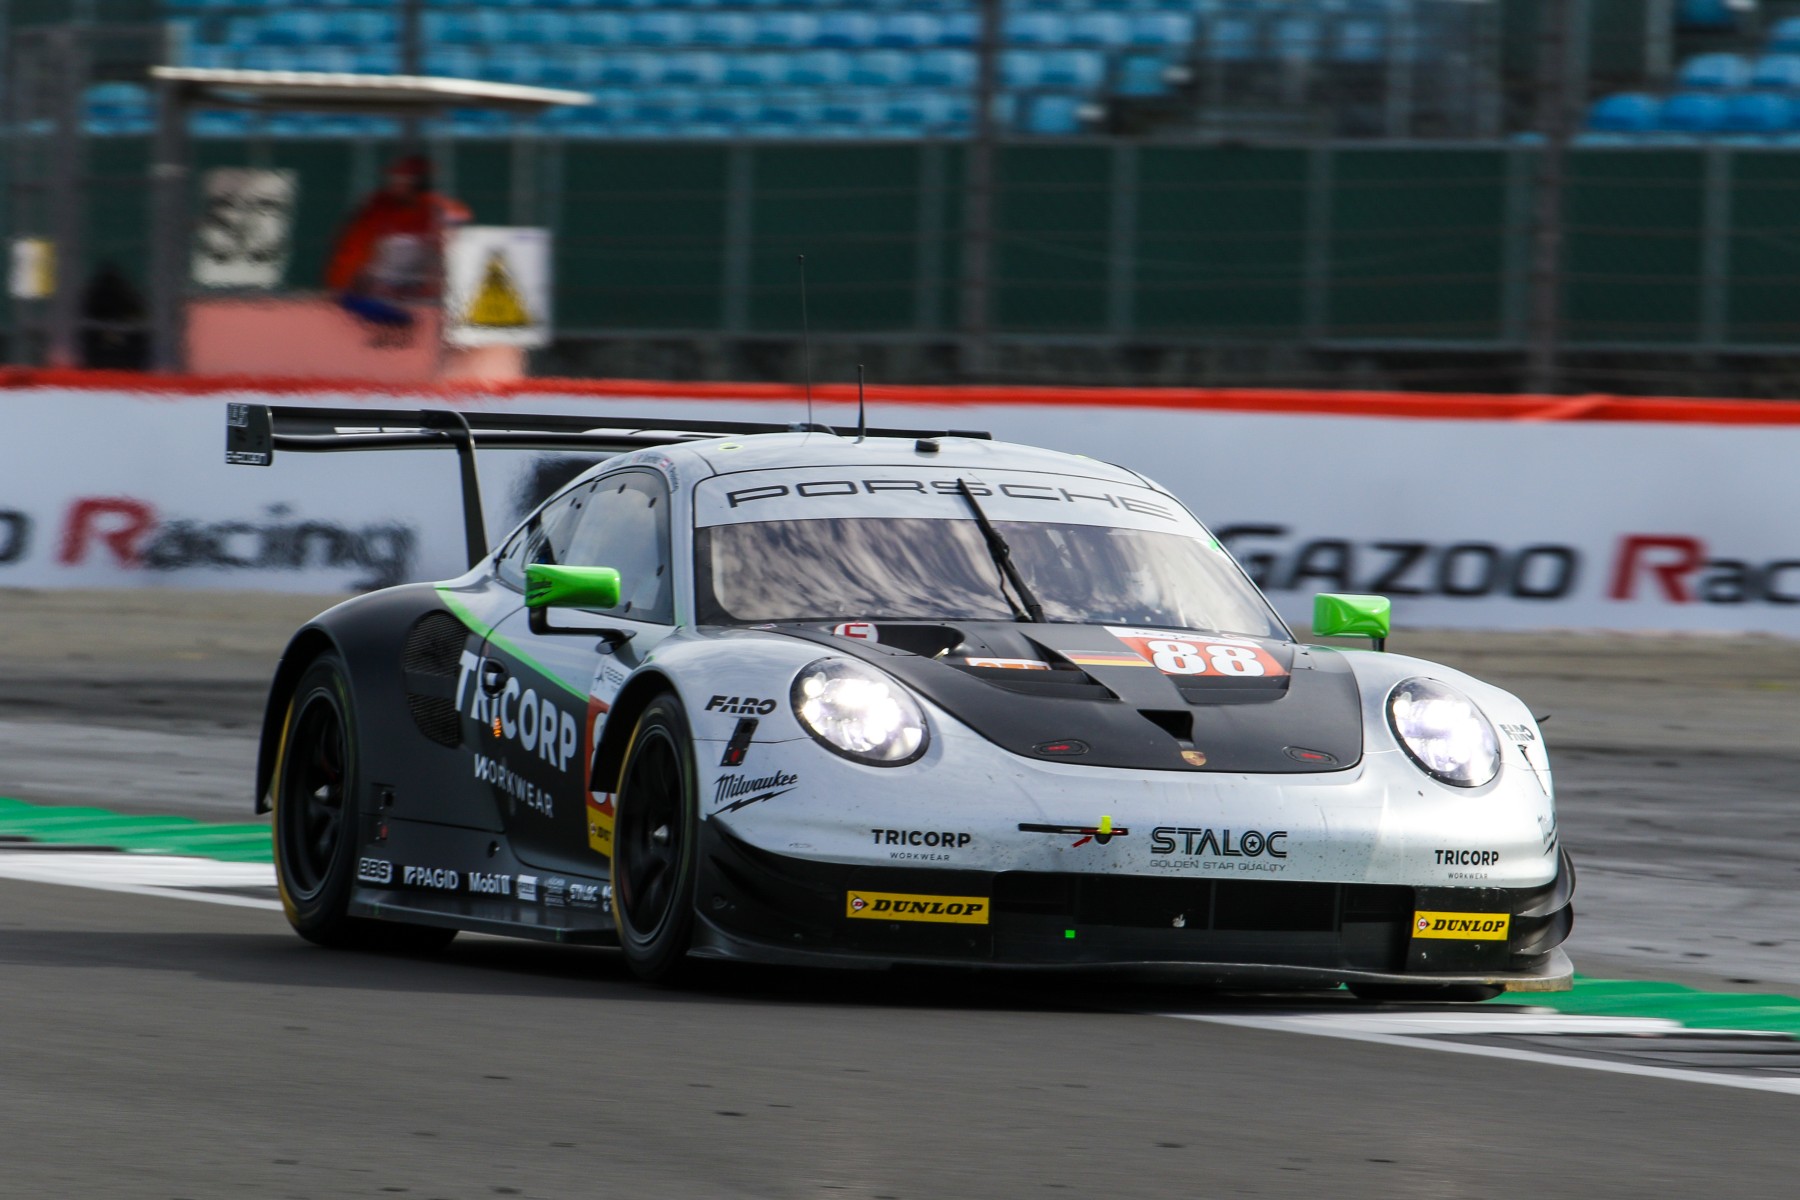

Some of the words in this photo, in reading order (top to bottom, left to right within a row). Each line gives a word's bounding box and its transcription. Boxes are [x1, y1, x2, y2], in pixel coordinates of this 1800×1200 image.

[725, 479, 1178, 523] PORSCHE
[56, 496, 416, 592] Racing
[1147, 640, 1265, 677] 88
[455, 649, 578, 773] TRICORP
[704, 695, 777, 715] FARO
[474, 753, 554, 818] WORKWEAR
[713, 770, 798, 804] Milwaukee
[871, 829, 972, 848] TRICORP
[1151, 827, 1287, 858] STALOC
[890, 852, 950, 861] WORKWEAR
[1150, 860, 1199, 869] GOLDEN
[1203, 861, 1234, 870] STAR
[1434, 850, 1500, 866] TRICORP
[416, 866, 460, 889] PAGID
[1447, 872, 1489, 880] WORKWEAR
[871, 899, 984, 916] DUNLOP
[1432, 919, 1505, 933] DUNLOP
